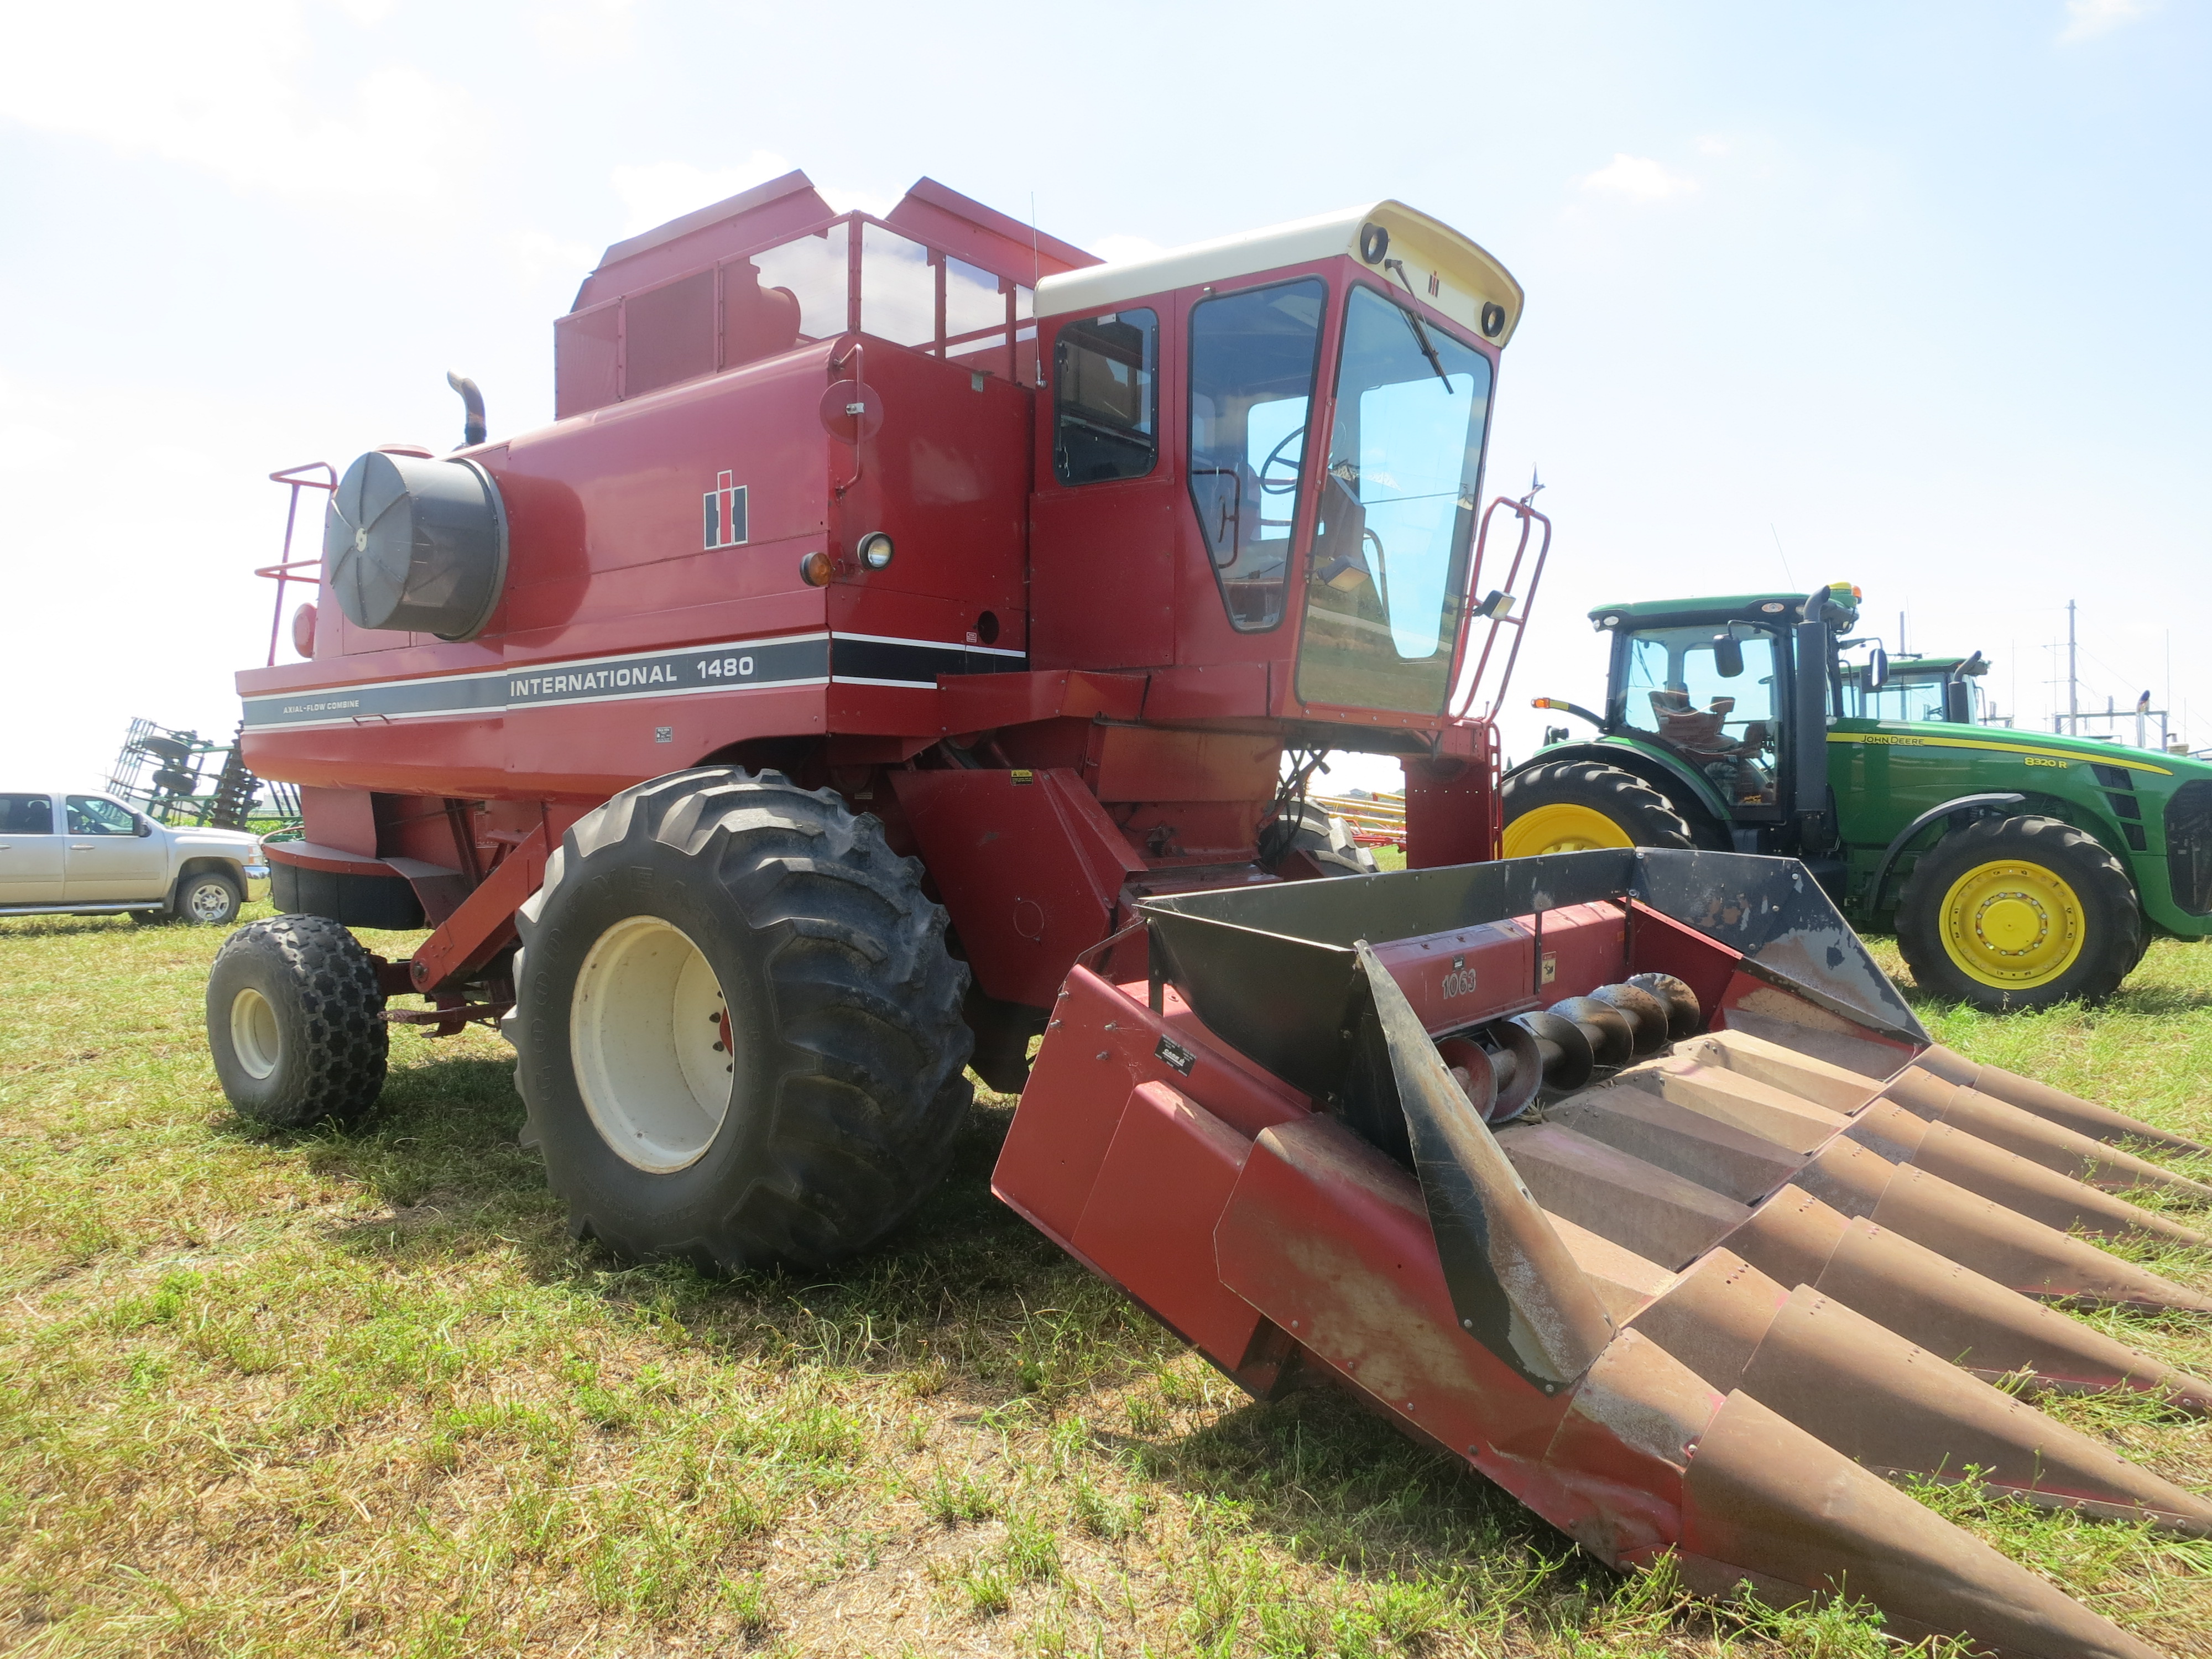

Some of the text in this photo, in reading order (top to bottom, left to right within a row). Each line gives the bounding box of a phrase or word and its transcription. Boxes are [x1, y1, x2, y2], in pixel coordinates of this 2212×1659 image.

[510, 656, 754, 697] INTERNATIONAL 1480
[283, 700, 359, 714] AXIAL-FLOW COMBINE
[1860, 735, 1924, 745] JOHN DEERE
[2024, 757, 2068, 769] 8320 R
[1442, 968, 1476, 1000] 1063
